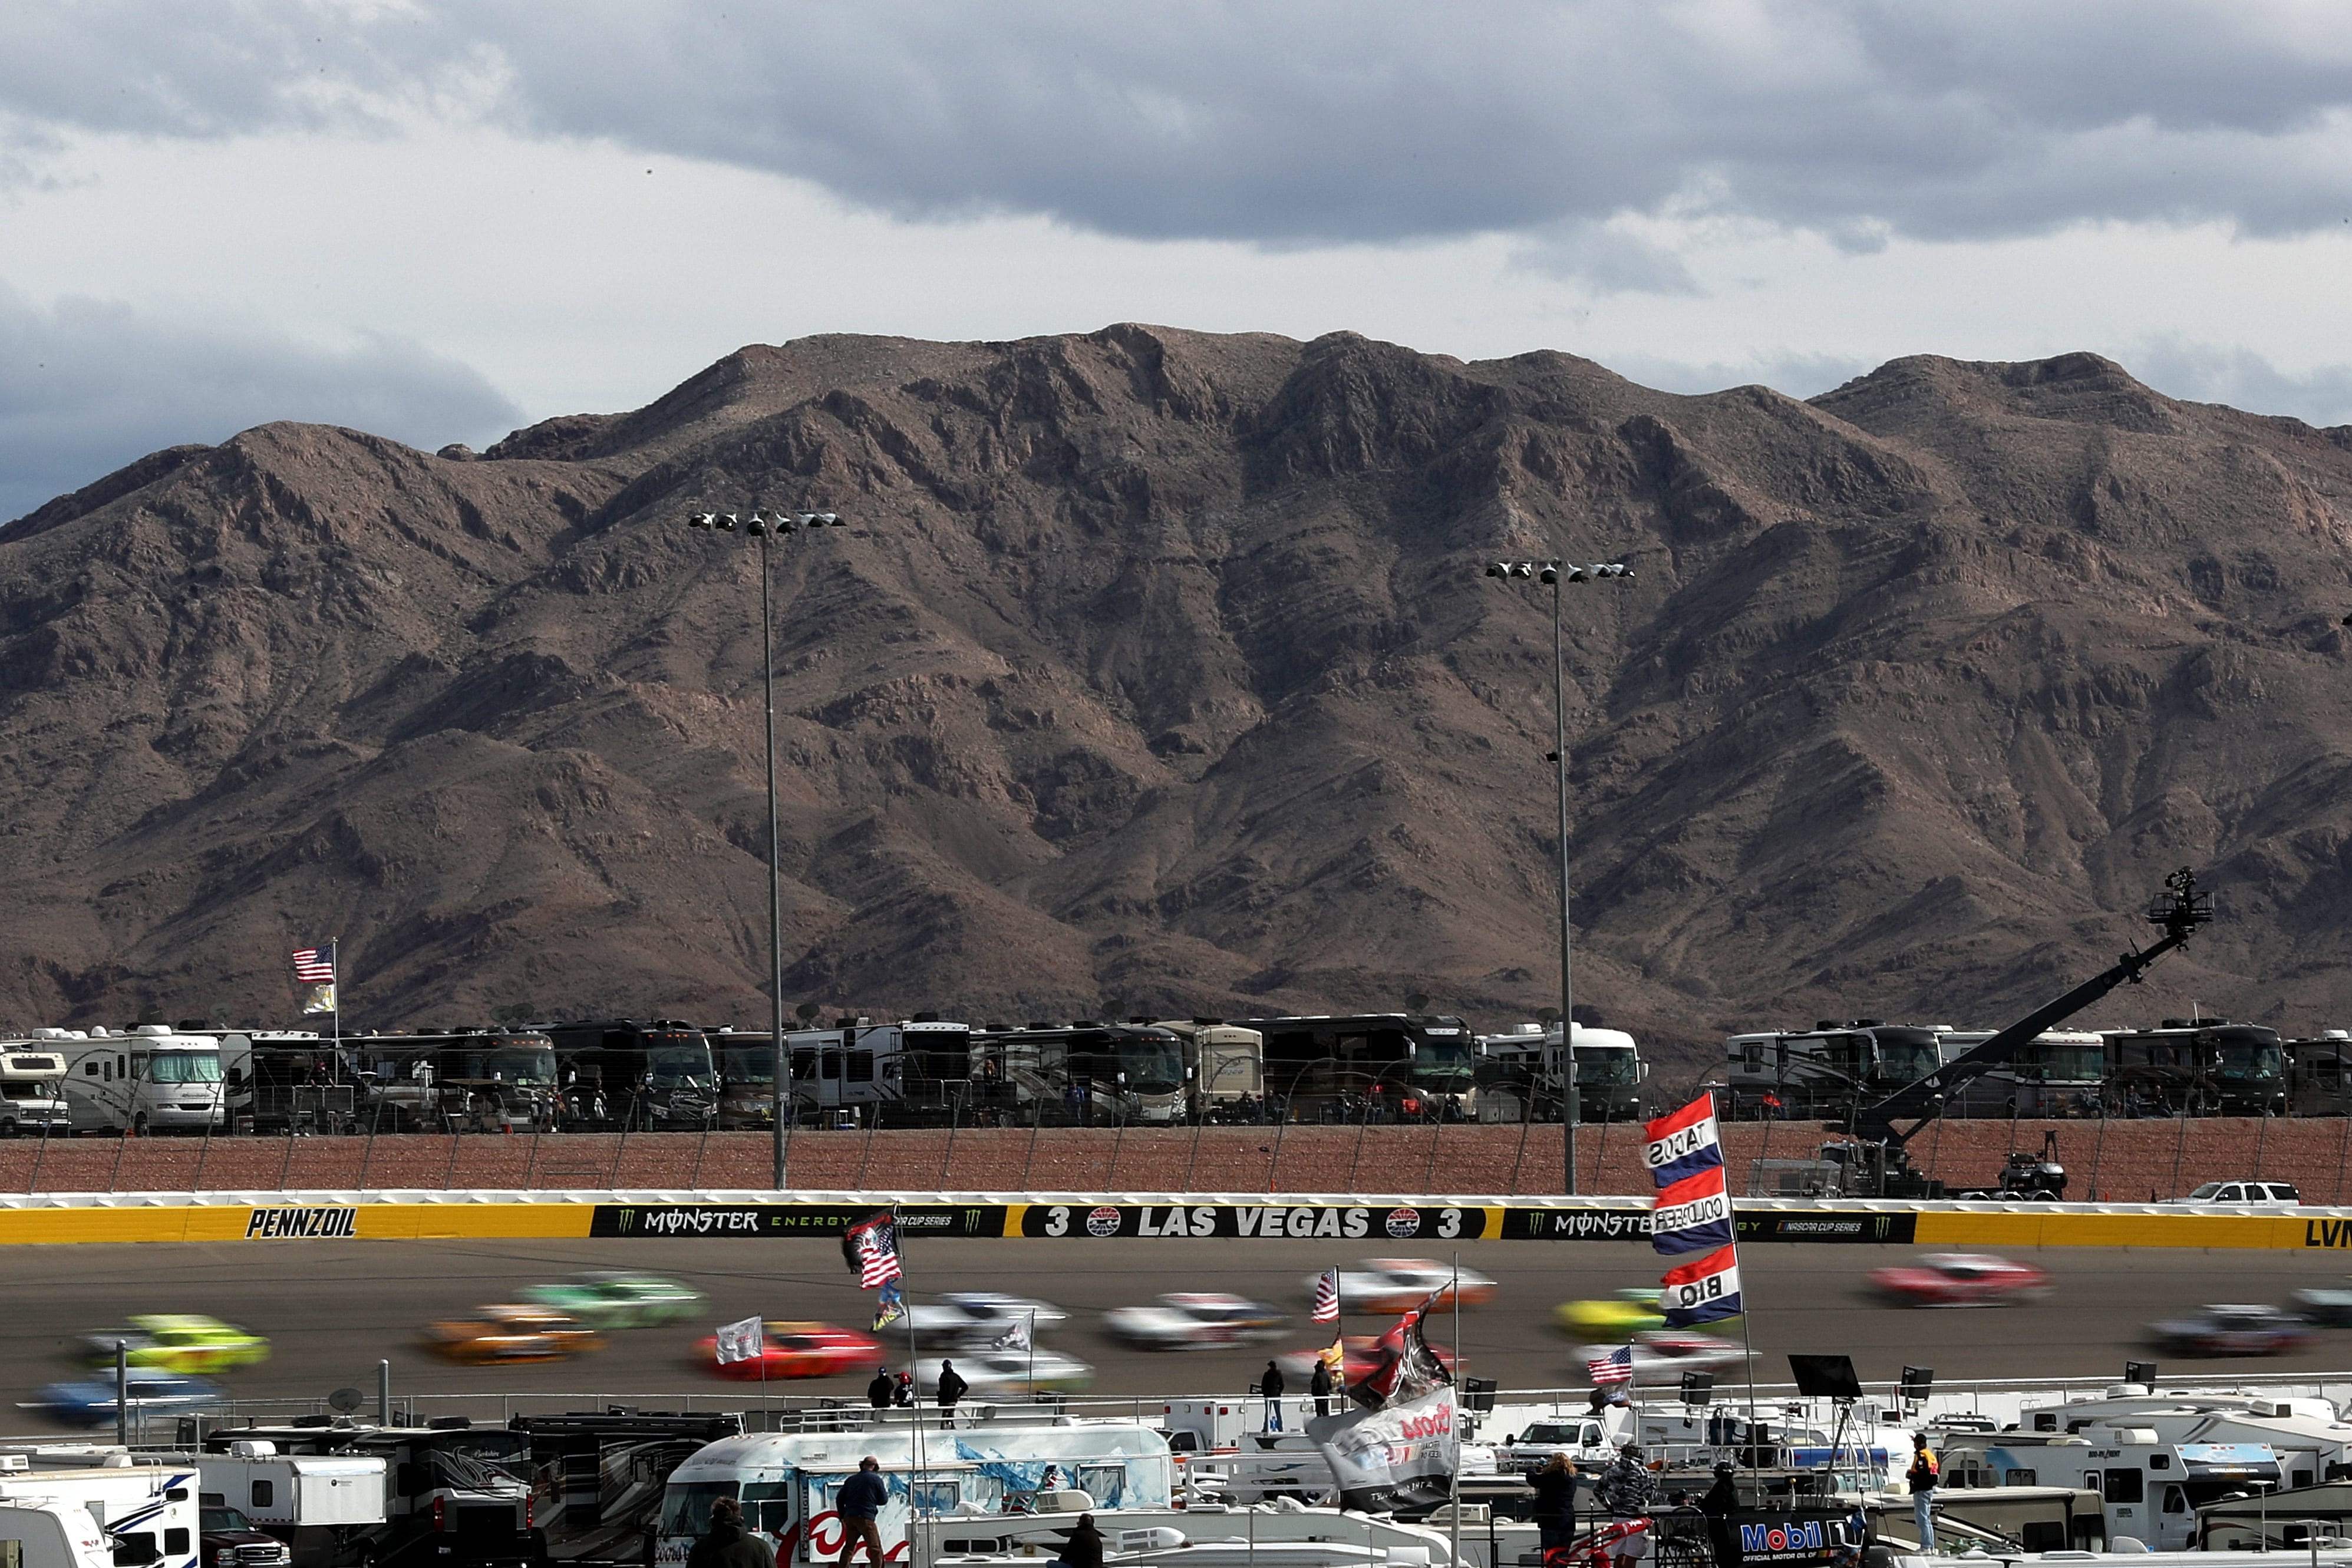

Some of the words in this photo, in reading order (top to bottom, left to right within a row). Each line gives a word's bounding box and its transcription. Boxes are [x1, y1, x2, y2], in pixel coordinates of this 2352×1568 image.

[245, 1207, 357, 1239] PENNZOIL
[645, 1208, 759, 1234] MONSTER
[771, 1217, 852, 1226] ENERGY
[908, 1216, 924, 1226] CUP
[924, 1216, 952, 1226] SERIES
[1045, 1206, 1070, 1237] 3
[1137, 1206, 1216, 1237] LAS
[1235, 1207, 1369, 1237] VEGAS
[1437, 1208, 1462, 1237] 3
[1555, 1212, 1652, 1236] MONSTE
[1786, 1222, 1818, 1232] NASCAR
[1818, 1223, 1834, 1232] CUP
[1833, 1223, 1862, 1232] SERIES
[1740, 1520, 1823, 1552] Mobil
[1743, 1553, 1771, 1562] OFFICIAL
[1772, 1552, 1796, 1560] MOTOR
